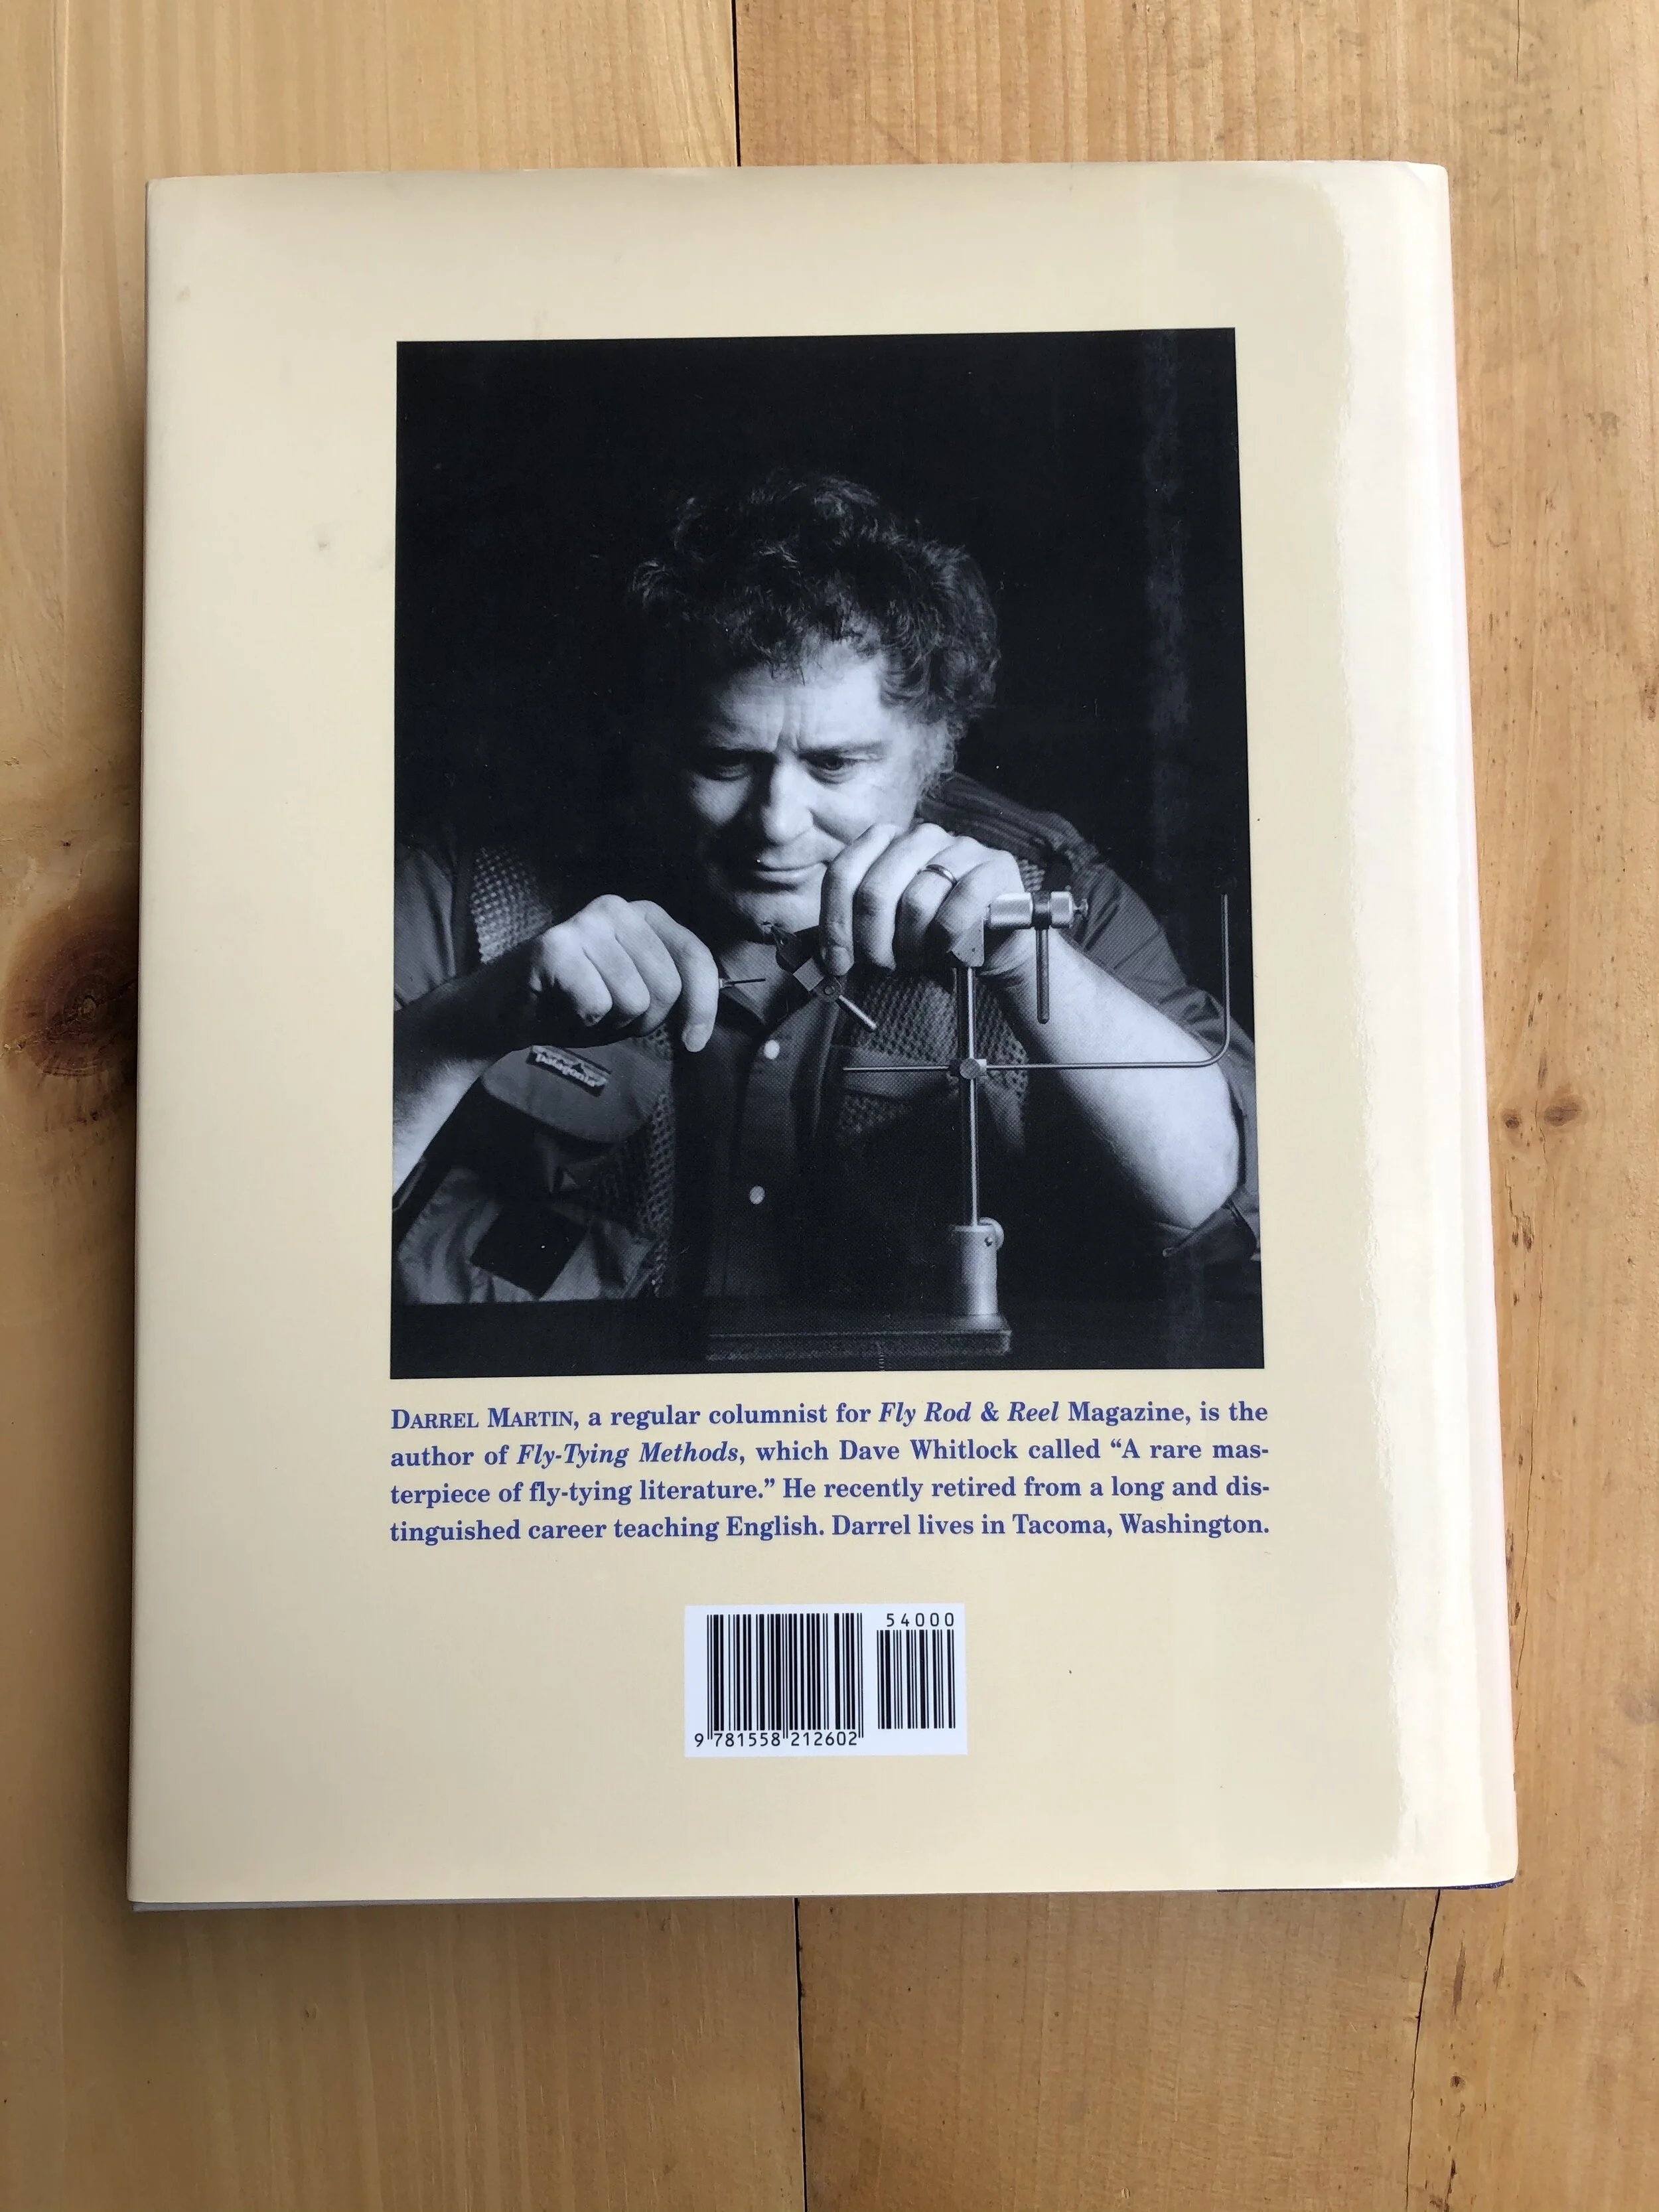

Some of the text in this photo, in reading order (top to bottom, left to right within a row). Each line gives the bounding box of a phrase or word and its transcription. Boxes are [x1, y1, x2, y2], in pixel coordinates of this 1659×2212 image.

[589, 1412, 601, 1426] a
[611, 1405, 700, 1430] regular
[709, 1403, 827, 1424] columnist
[836, 1403, 871, 1422] for
[879, 1402, 916, 1427] Fly
[924, 1402, 971, 1422] Rod
[981, 1402, 999, 1422] &
[1007, 1402, 1058, 1422] Reel
[1068, 1402, 1190, 1426] Magazine,
[1200, 1401, 1219, 1421] is
[1229, 1401, 1267, 1421] the
[391, 1438, 1268, 1469] author of Fly-Tying Methods, which Dave Whitlock called “A rare mas-
[391, 1476, 1269, 1509] terpiece of fly-tying literature.” He recently retired from a long and dis-
[390, 1513, 1269, 1546] tinguished career teaching English. Darrel lives in Tacoma, Washington.
